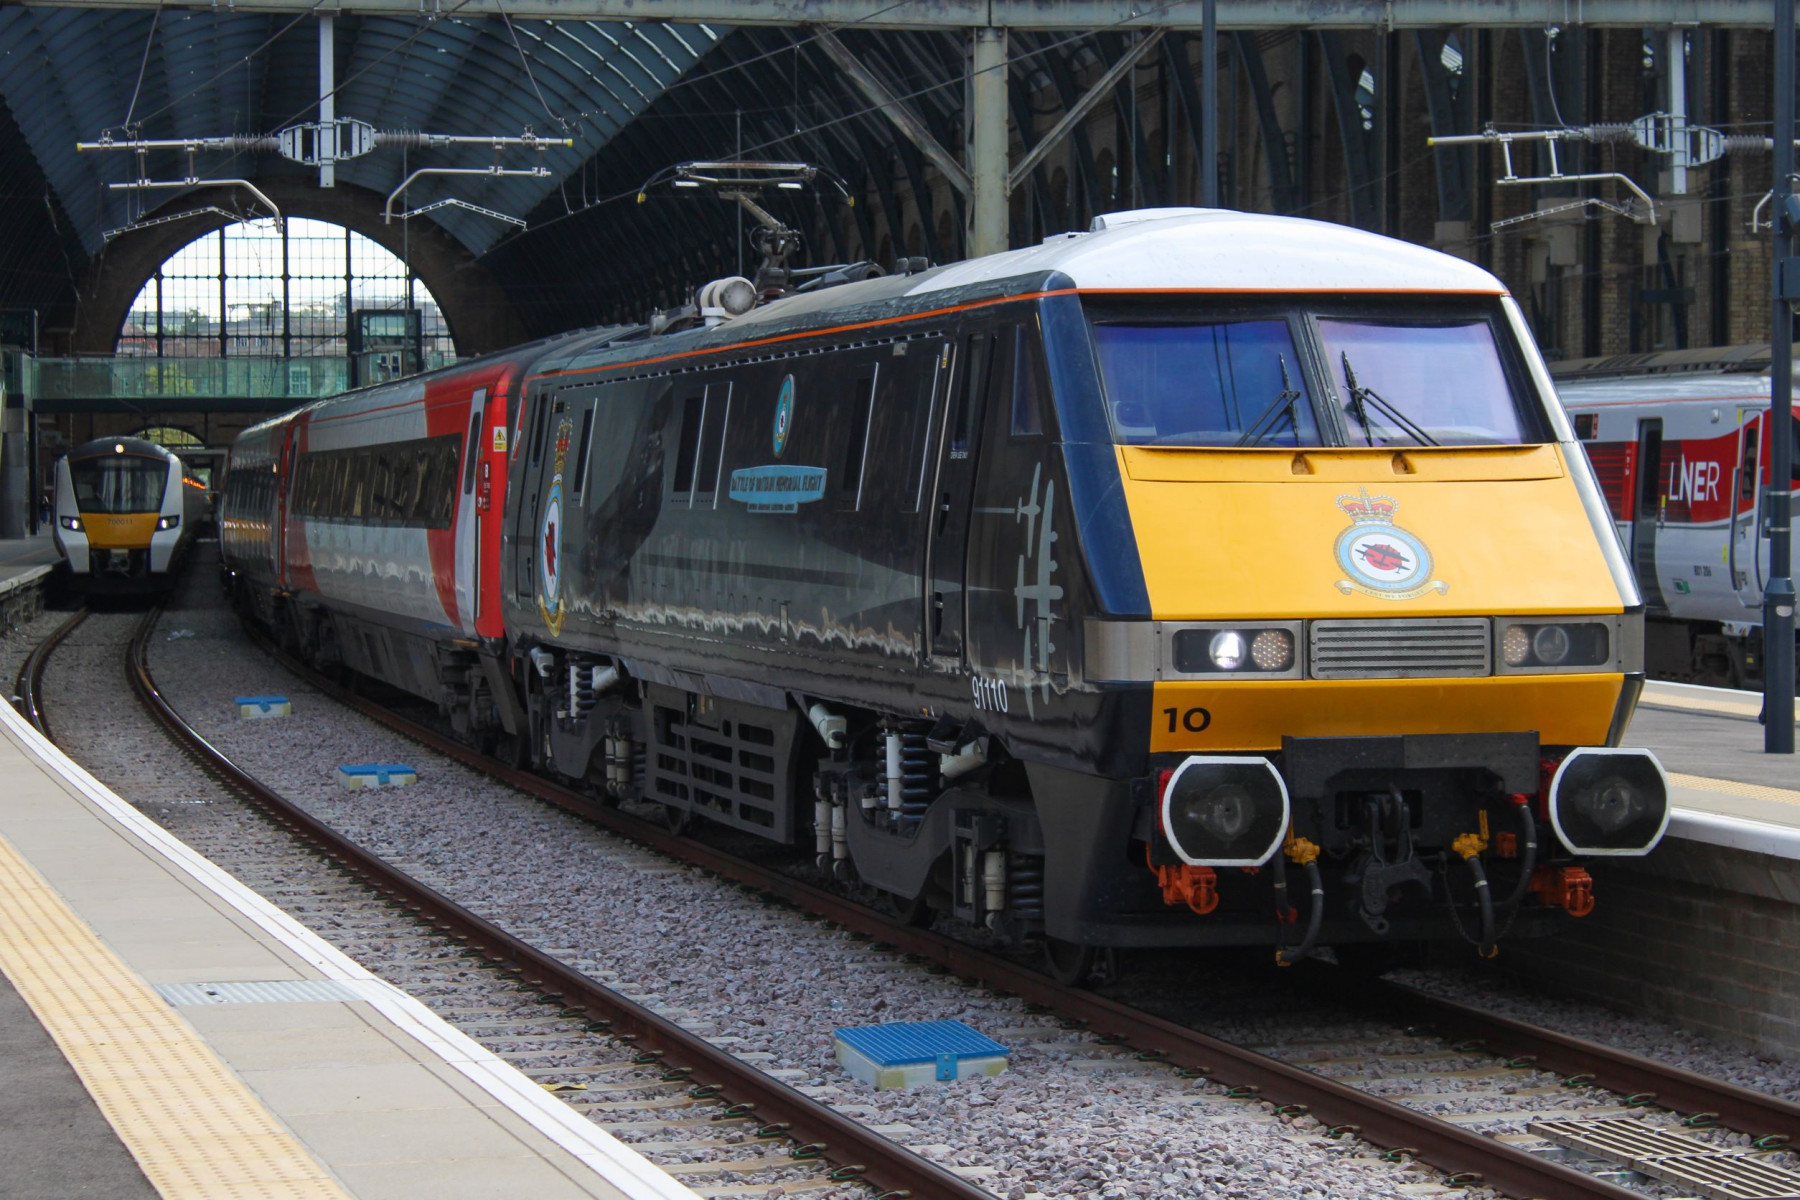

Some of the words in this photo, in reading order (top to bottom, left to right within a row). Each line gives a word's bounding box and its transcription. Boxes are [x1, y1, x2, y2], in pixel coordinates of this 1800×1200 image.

[801, 474, 823, 491] FLIGHT
[1669, 453, 1720, 509] LNER
[107, 518, 133, 526] 700011
[972, 676, 1008, 713] 91110
[1163, 707, 1211, 733] 10
